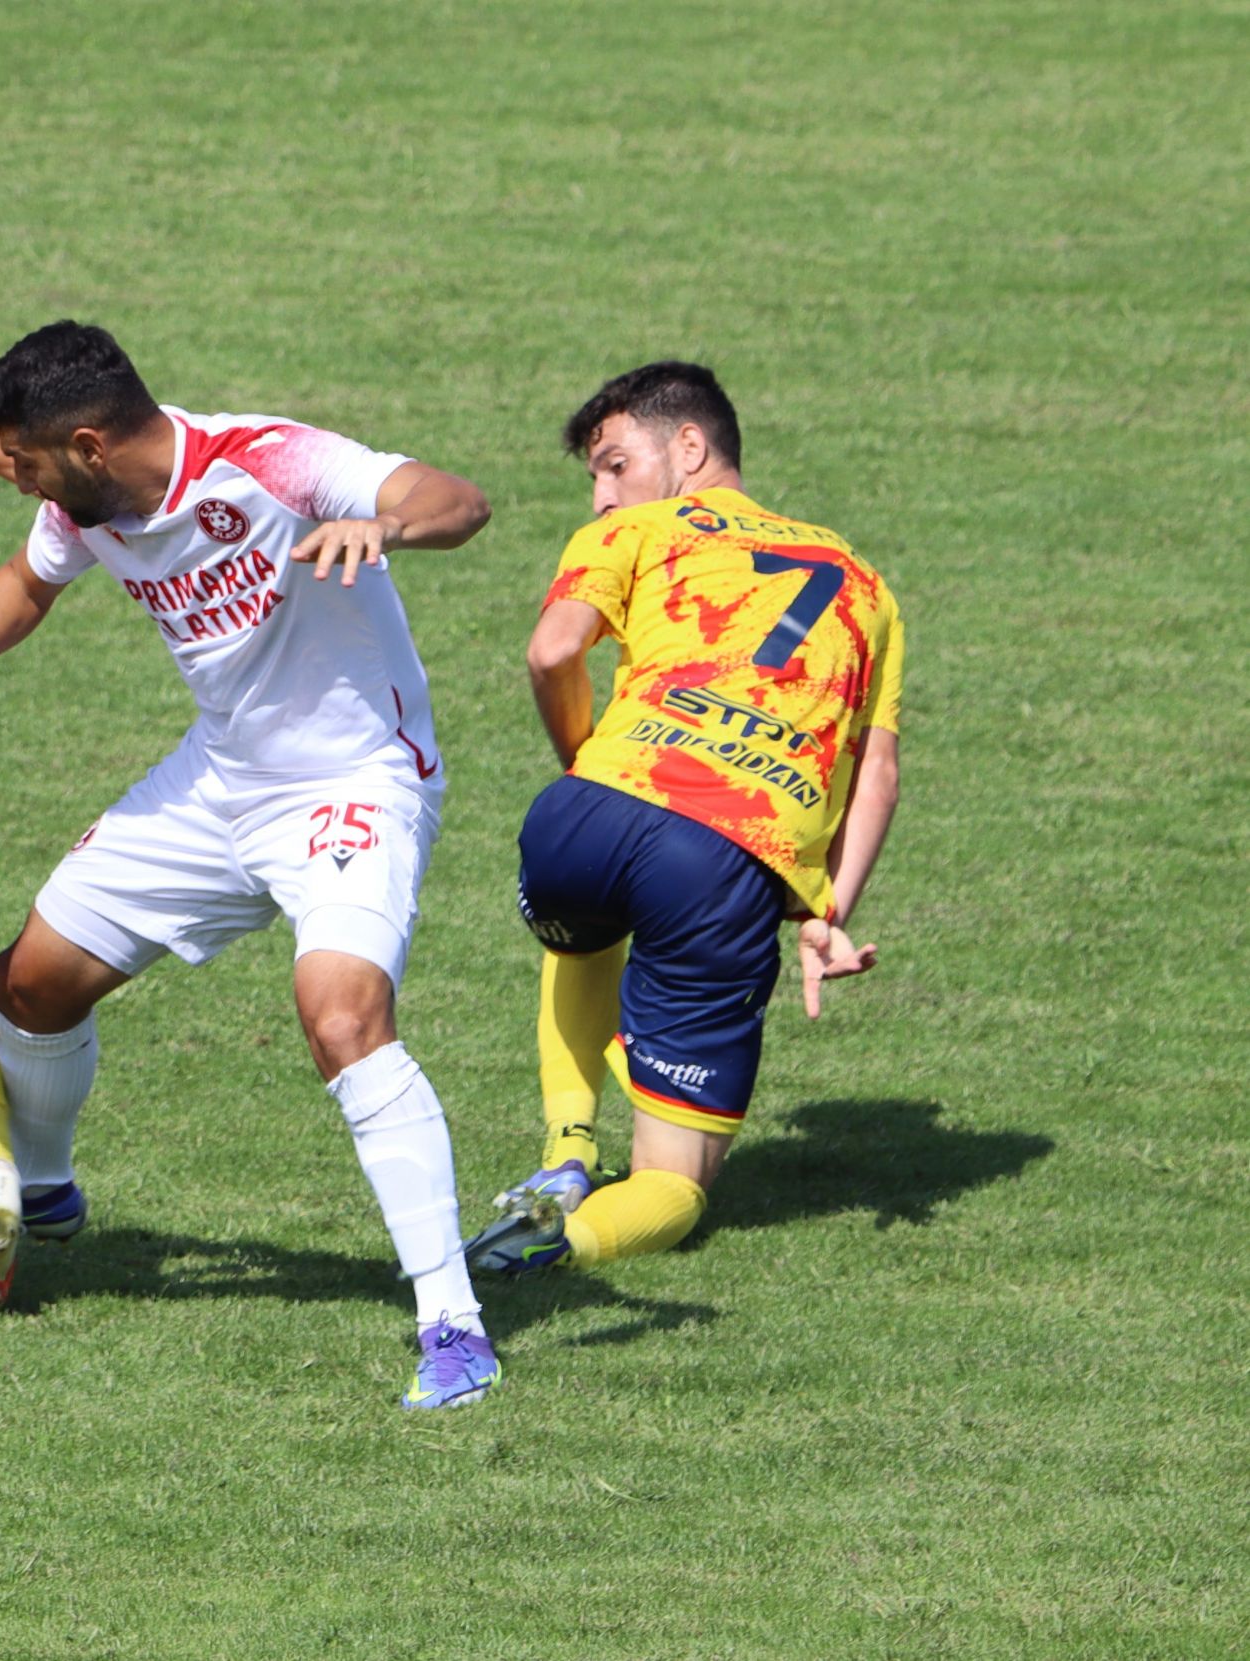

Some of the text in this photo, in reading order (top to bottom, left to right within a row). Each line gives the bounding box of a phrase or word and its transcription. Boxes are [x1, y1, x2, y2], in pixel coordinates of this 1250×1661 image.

[152, 589, 285, 643] LATINA
[750, 550, 845, 670] 7
[308, 802, 384, 859] 25
